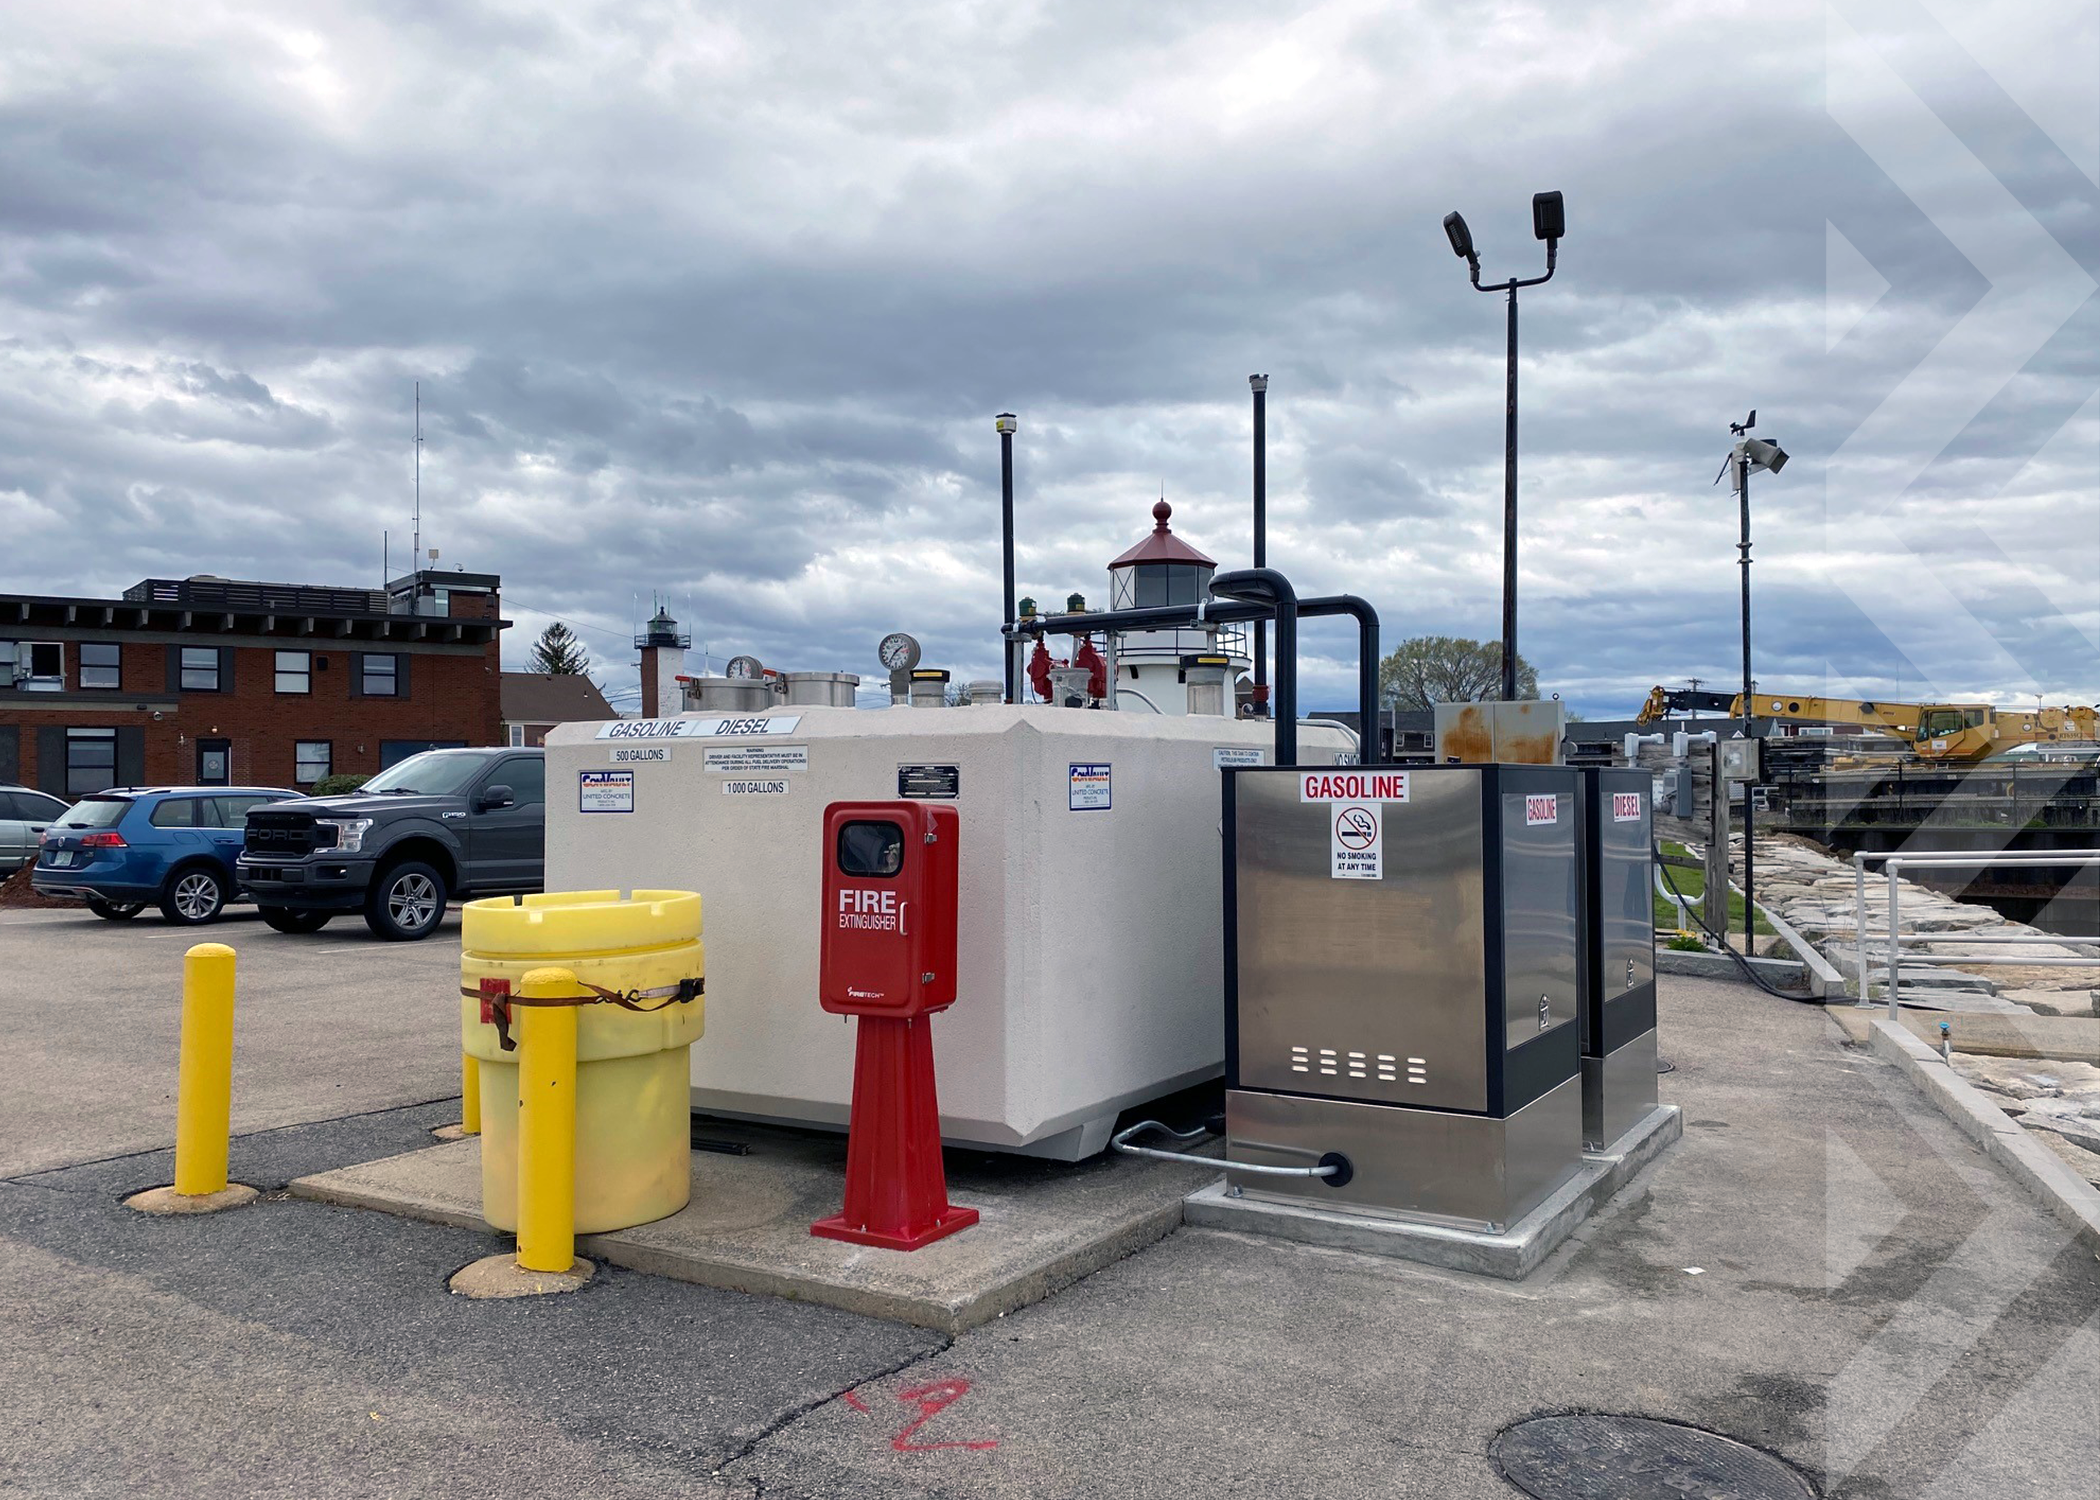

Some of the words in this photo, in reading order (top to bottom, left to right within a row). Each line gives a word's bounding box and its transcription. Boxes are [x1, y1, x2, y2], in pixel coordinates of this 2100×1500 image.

[609, 721, 686, 738] GASOLINE
[715, 718, 770, 735] DIESEL
[616, 750, 629, 761] 500
[629, 749, 664, 761] GALLONS
[747, 782, 784, 793] GALLONS
[1305, 775, 1404, 799] GASOLINE
[1528, 798, 1556, 821] GASOLINE
[1615, 795, 1640, 817] DIESEL
[246, 829, 308, 840] FORD
[1337, 852, 1346, 860] NO
[1347, 852, 1377, 860] SMOKING
[1347, 863, 1360, 871] ANY
[1361, 863, 1376, 871] TIME
[839, 889, 896, 914] FIRE
[839, 913, 896, 931] EXTINGUISHER
